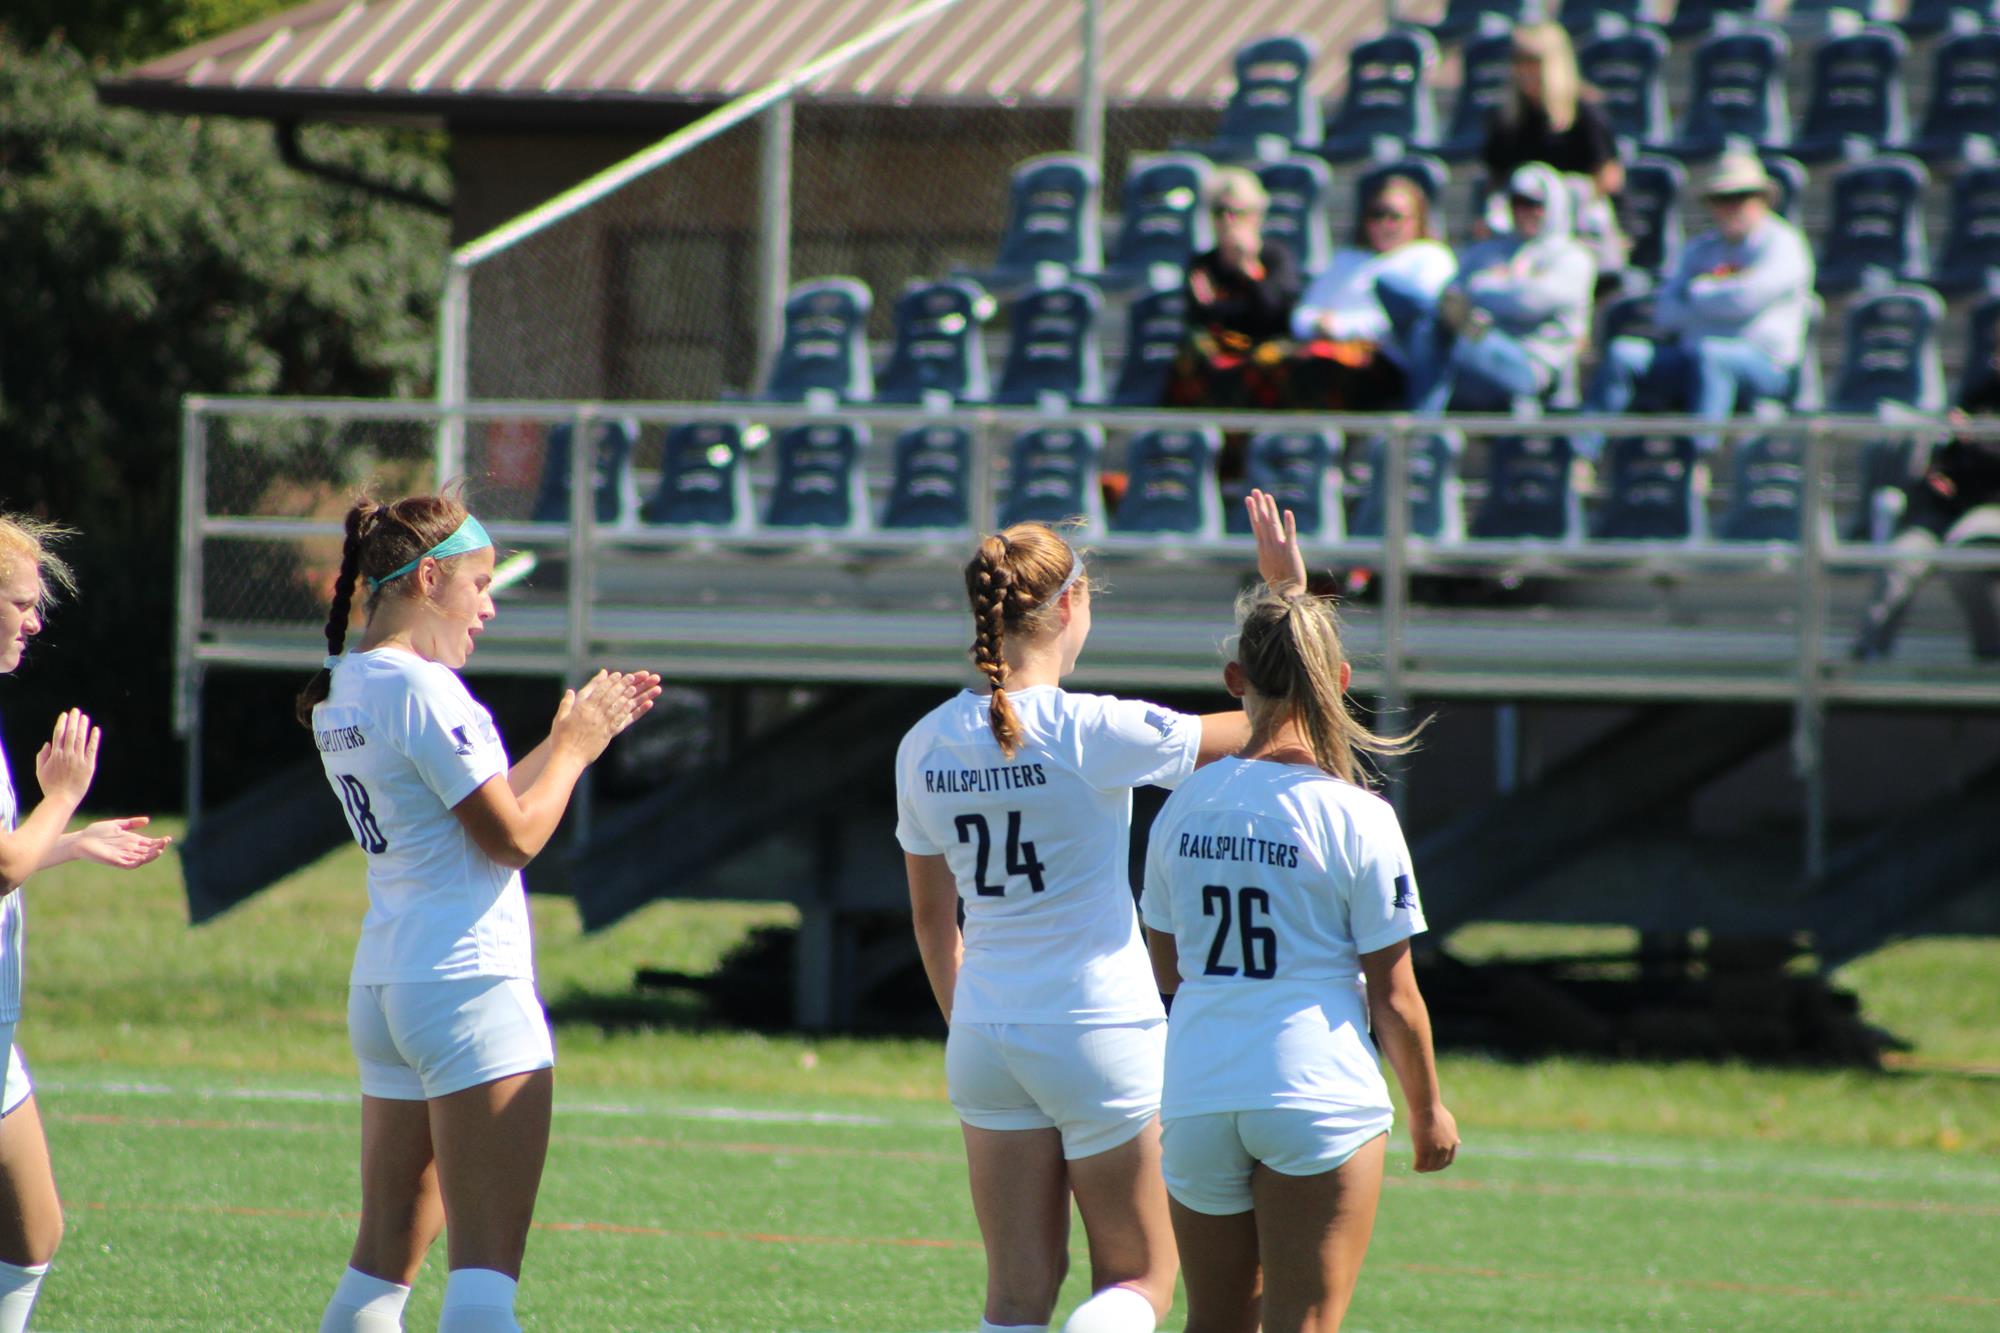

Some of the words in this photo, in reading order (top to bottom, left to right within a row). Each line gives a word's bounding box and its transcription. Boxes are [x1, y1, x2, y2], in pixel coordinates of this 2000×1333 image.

[336, 774, 388, 854] 18
[926, 763, 1046, 793] RAILSPLITTERS
[954, 811, 1045, 896] 24
[1179, 832, 1299, 869] RAILSPLITTERS
[1202, 884, 1277, 979] 26
